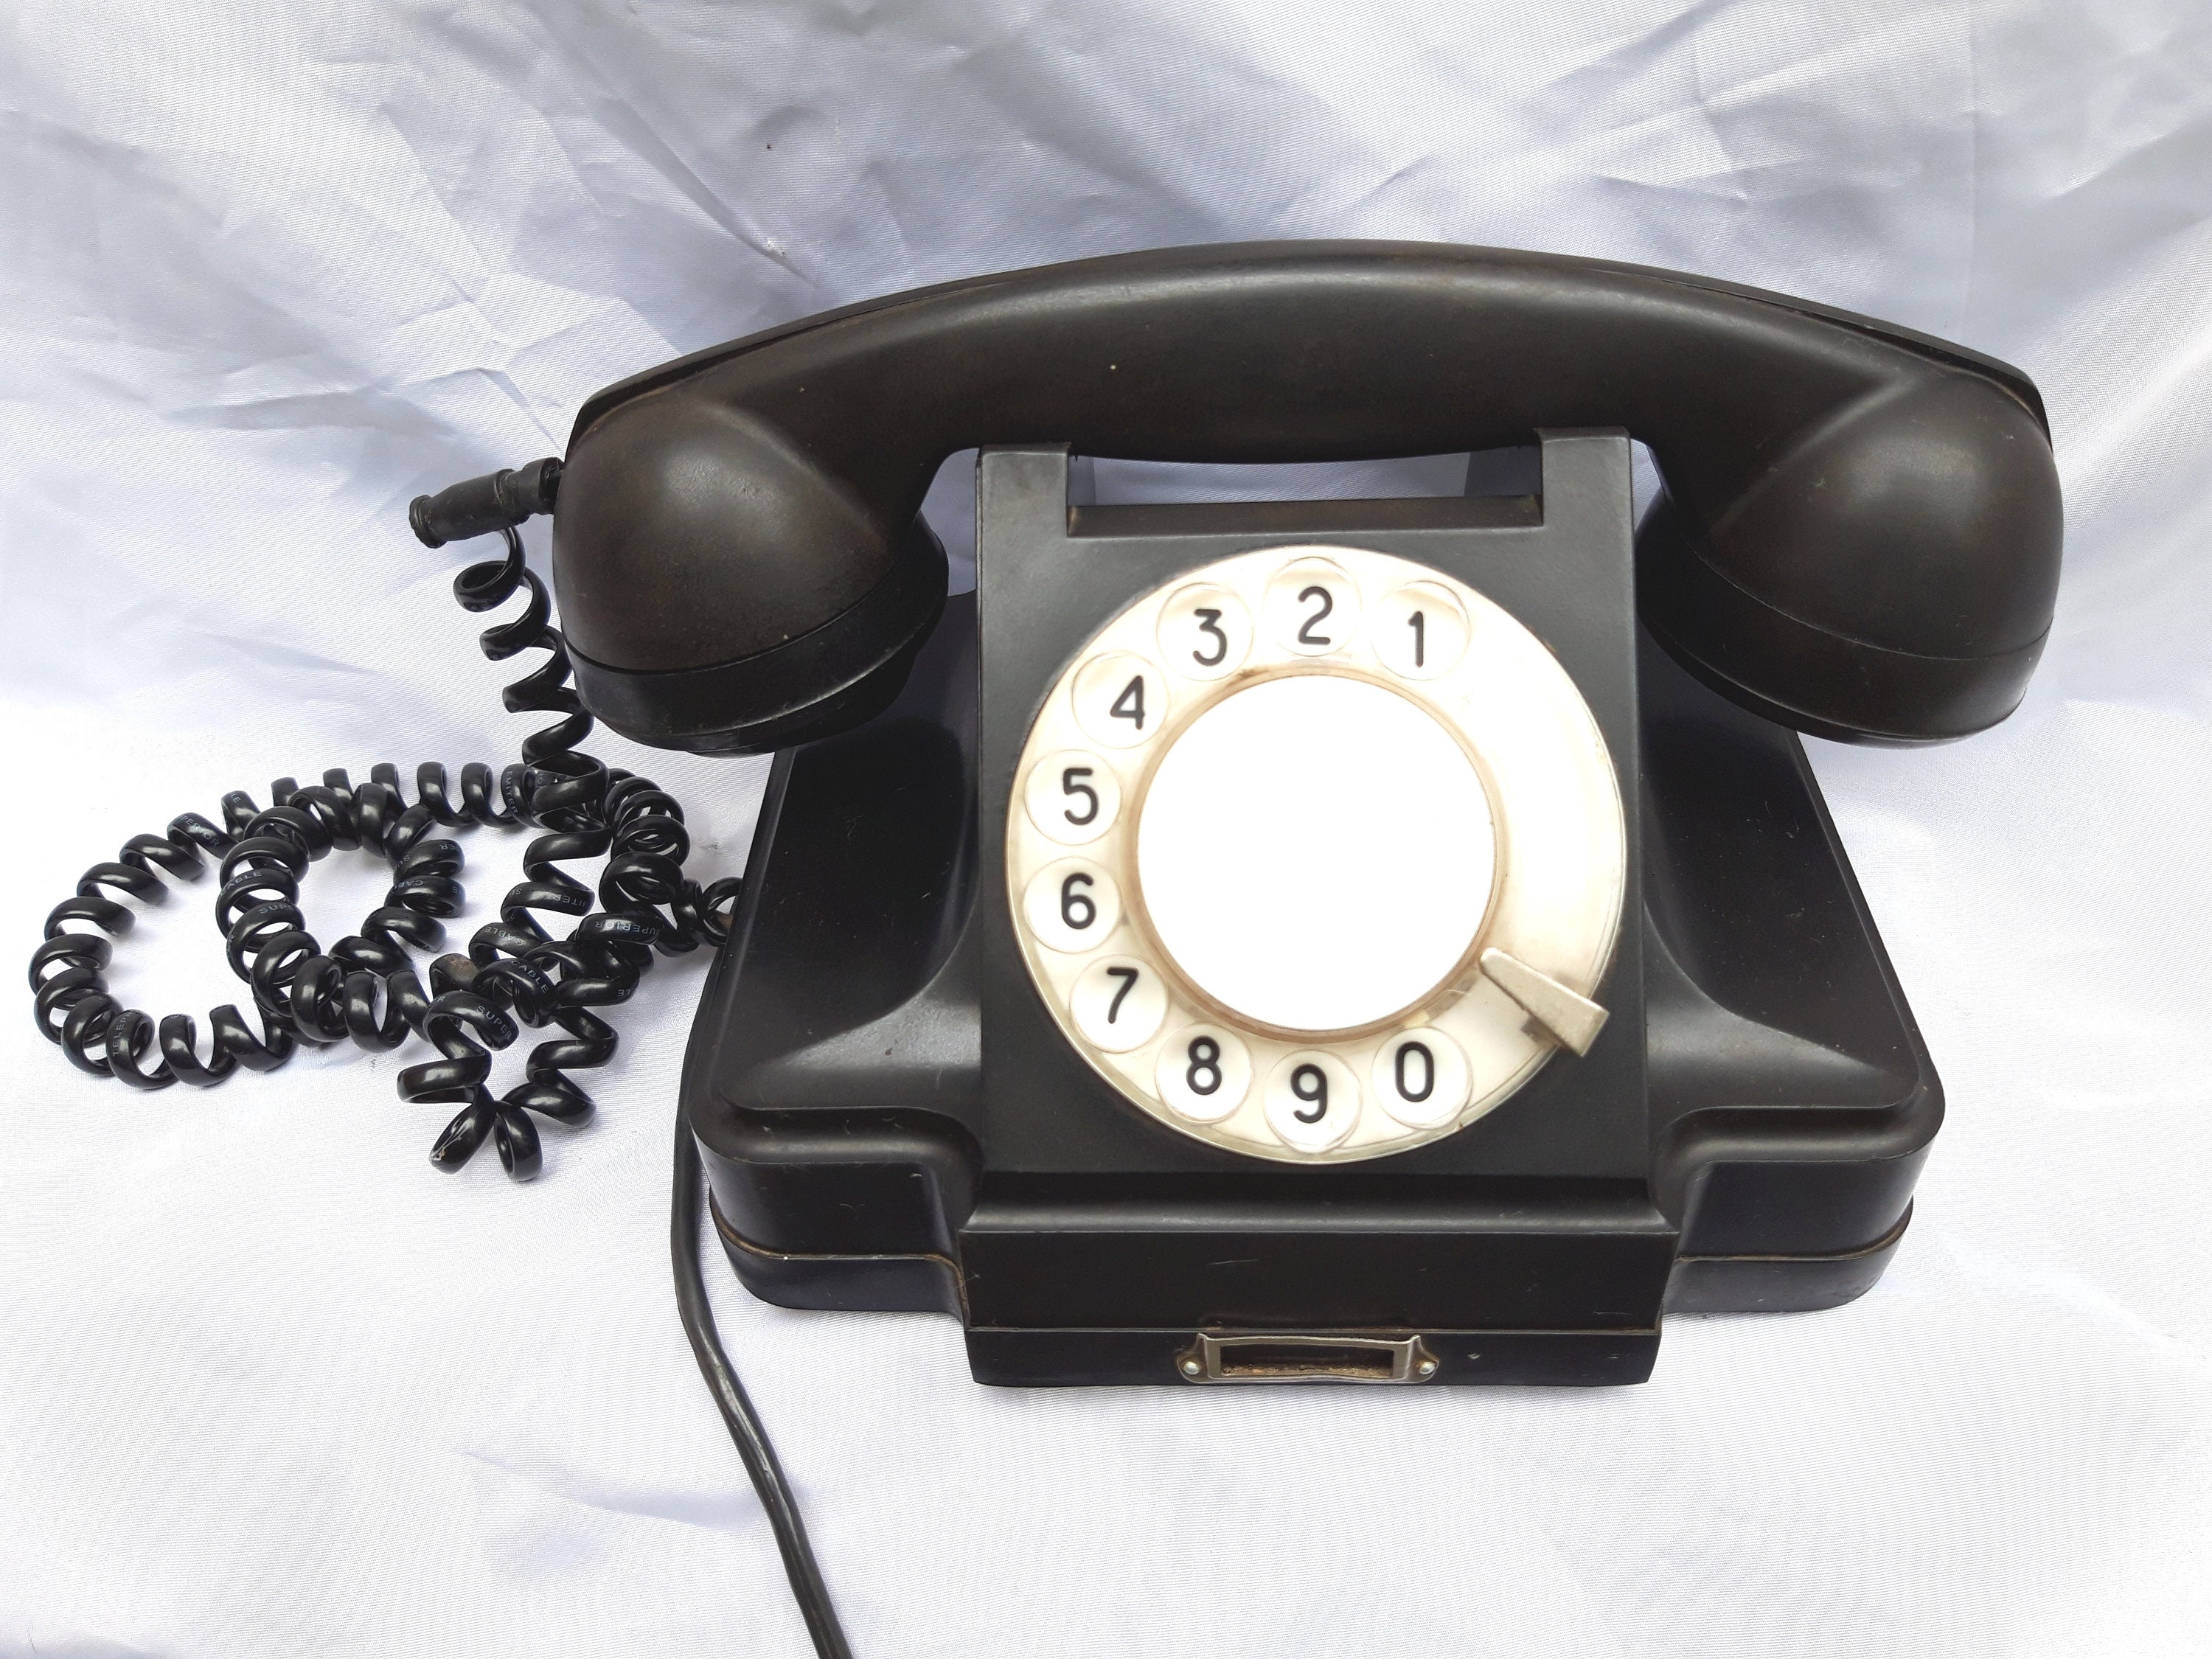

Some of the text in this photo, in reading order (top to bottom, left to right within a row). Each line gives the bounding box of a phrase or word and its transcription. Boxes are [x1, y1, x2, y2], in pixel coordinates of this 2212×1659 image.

[1193, 608, 1227, 666] 3
[1298, 585, 1333, 644] 2
[1409, 611, 1424, 667] 1
[1110, 675, 1144, 730] 4
[1062, 768, 1099, 825] 5
[594, 920, 661, 936] SUPERIOR
[1061, 872, 1096, 930] 6
[511, 960, 549, 994] CABLE
[1106, 966, 1139, 1024] 7
[1186, 1035, 1222, 1096] 8
[1290, 1062, 1328, 1124] 9
[1394, 1040, 1435, 1103] 0
